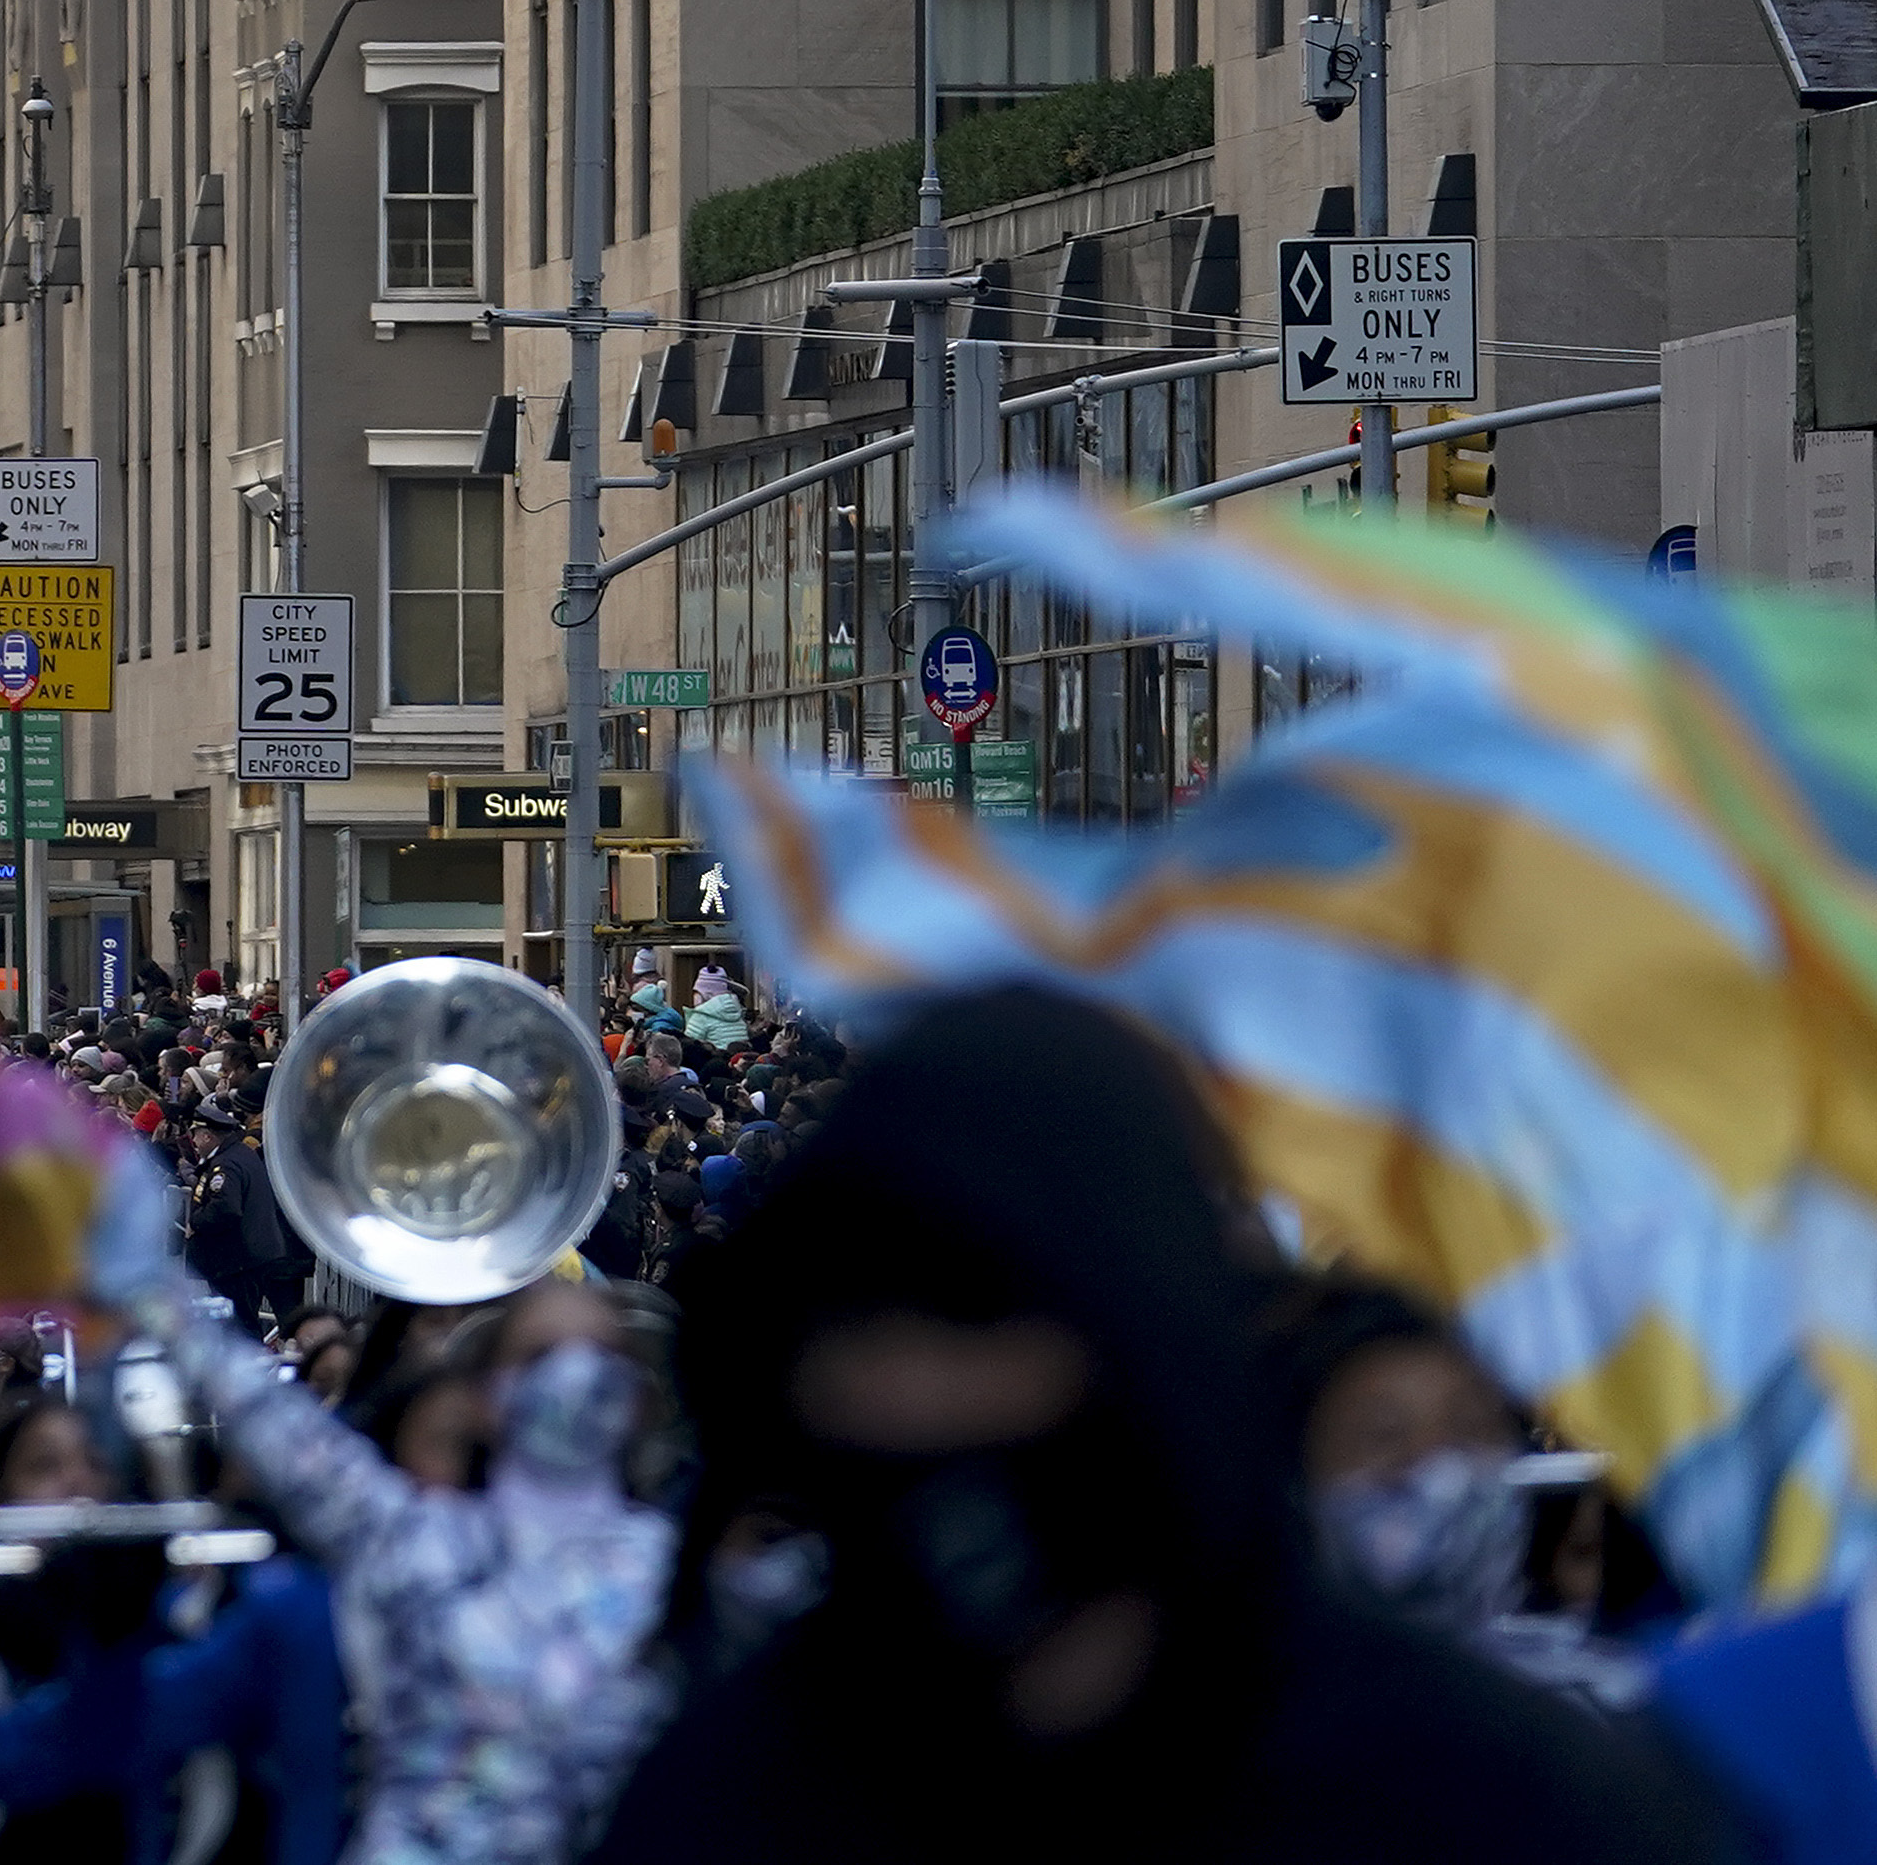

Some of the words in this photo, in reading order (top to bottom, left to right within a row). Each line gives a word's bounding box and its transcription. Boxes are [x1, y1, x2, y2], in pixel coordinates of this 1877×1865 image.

[1353, 252, 1451, 283] BUSES
[1354, 292, 1363, 303] &
[1369, 290, 1405, 303] RIGHT
[1411, 289, 1451, 302] TURNS
[1363, 309, 1441, 339] ONLY
[1347, 371, 1385, 390] MON
[1393, 376, 1426, 389] THRU
[1433, 370, 1460, 389] FRI
[1, 471, 76, 489] BUSES
[10, 497, 67, 515] ONLY
[11, 540, 39, 551] MON
[42, 543, 65, 551] THRU
[67, 539, 88, 551] FRI
[272, 605, 317, 620] CITY
[262, 626, 327, 642] SPEED
[43, 655, 56, 672] N
[269, 648, 320, 663] LIMIT
[38, 685, 75, 699] AVE
[254, 672, 337, 722] 25
[631, 675, 647, 703] W
[652, 674, 679, 702] 48
[683, 675, 702, 689] ST
[930, 699, 945, 716] NO
[945, 699, 990, 724] STANDING
[266, 744, 322, 758] PHOTO
[910, 747, 953, 771] QM15
[248, 760, 340, 773] ENFORCED
[911, 778, 955, 800] QM16
[484, 793, 567, 817] Subwa
[64, 819, 131, 842] ubway
[102, 951, 117, 1008] Avenue
